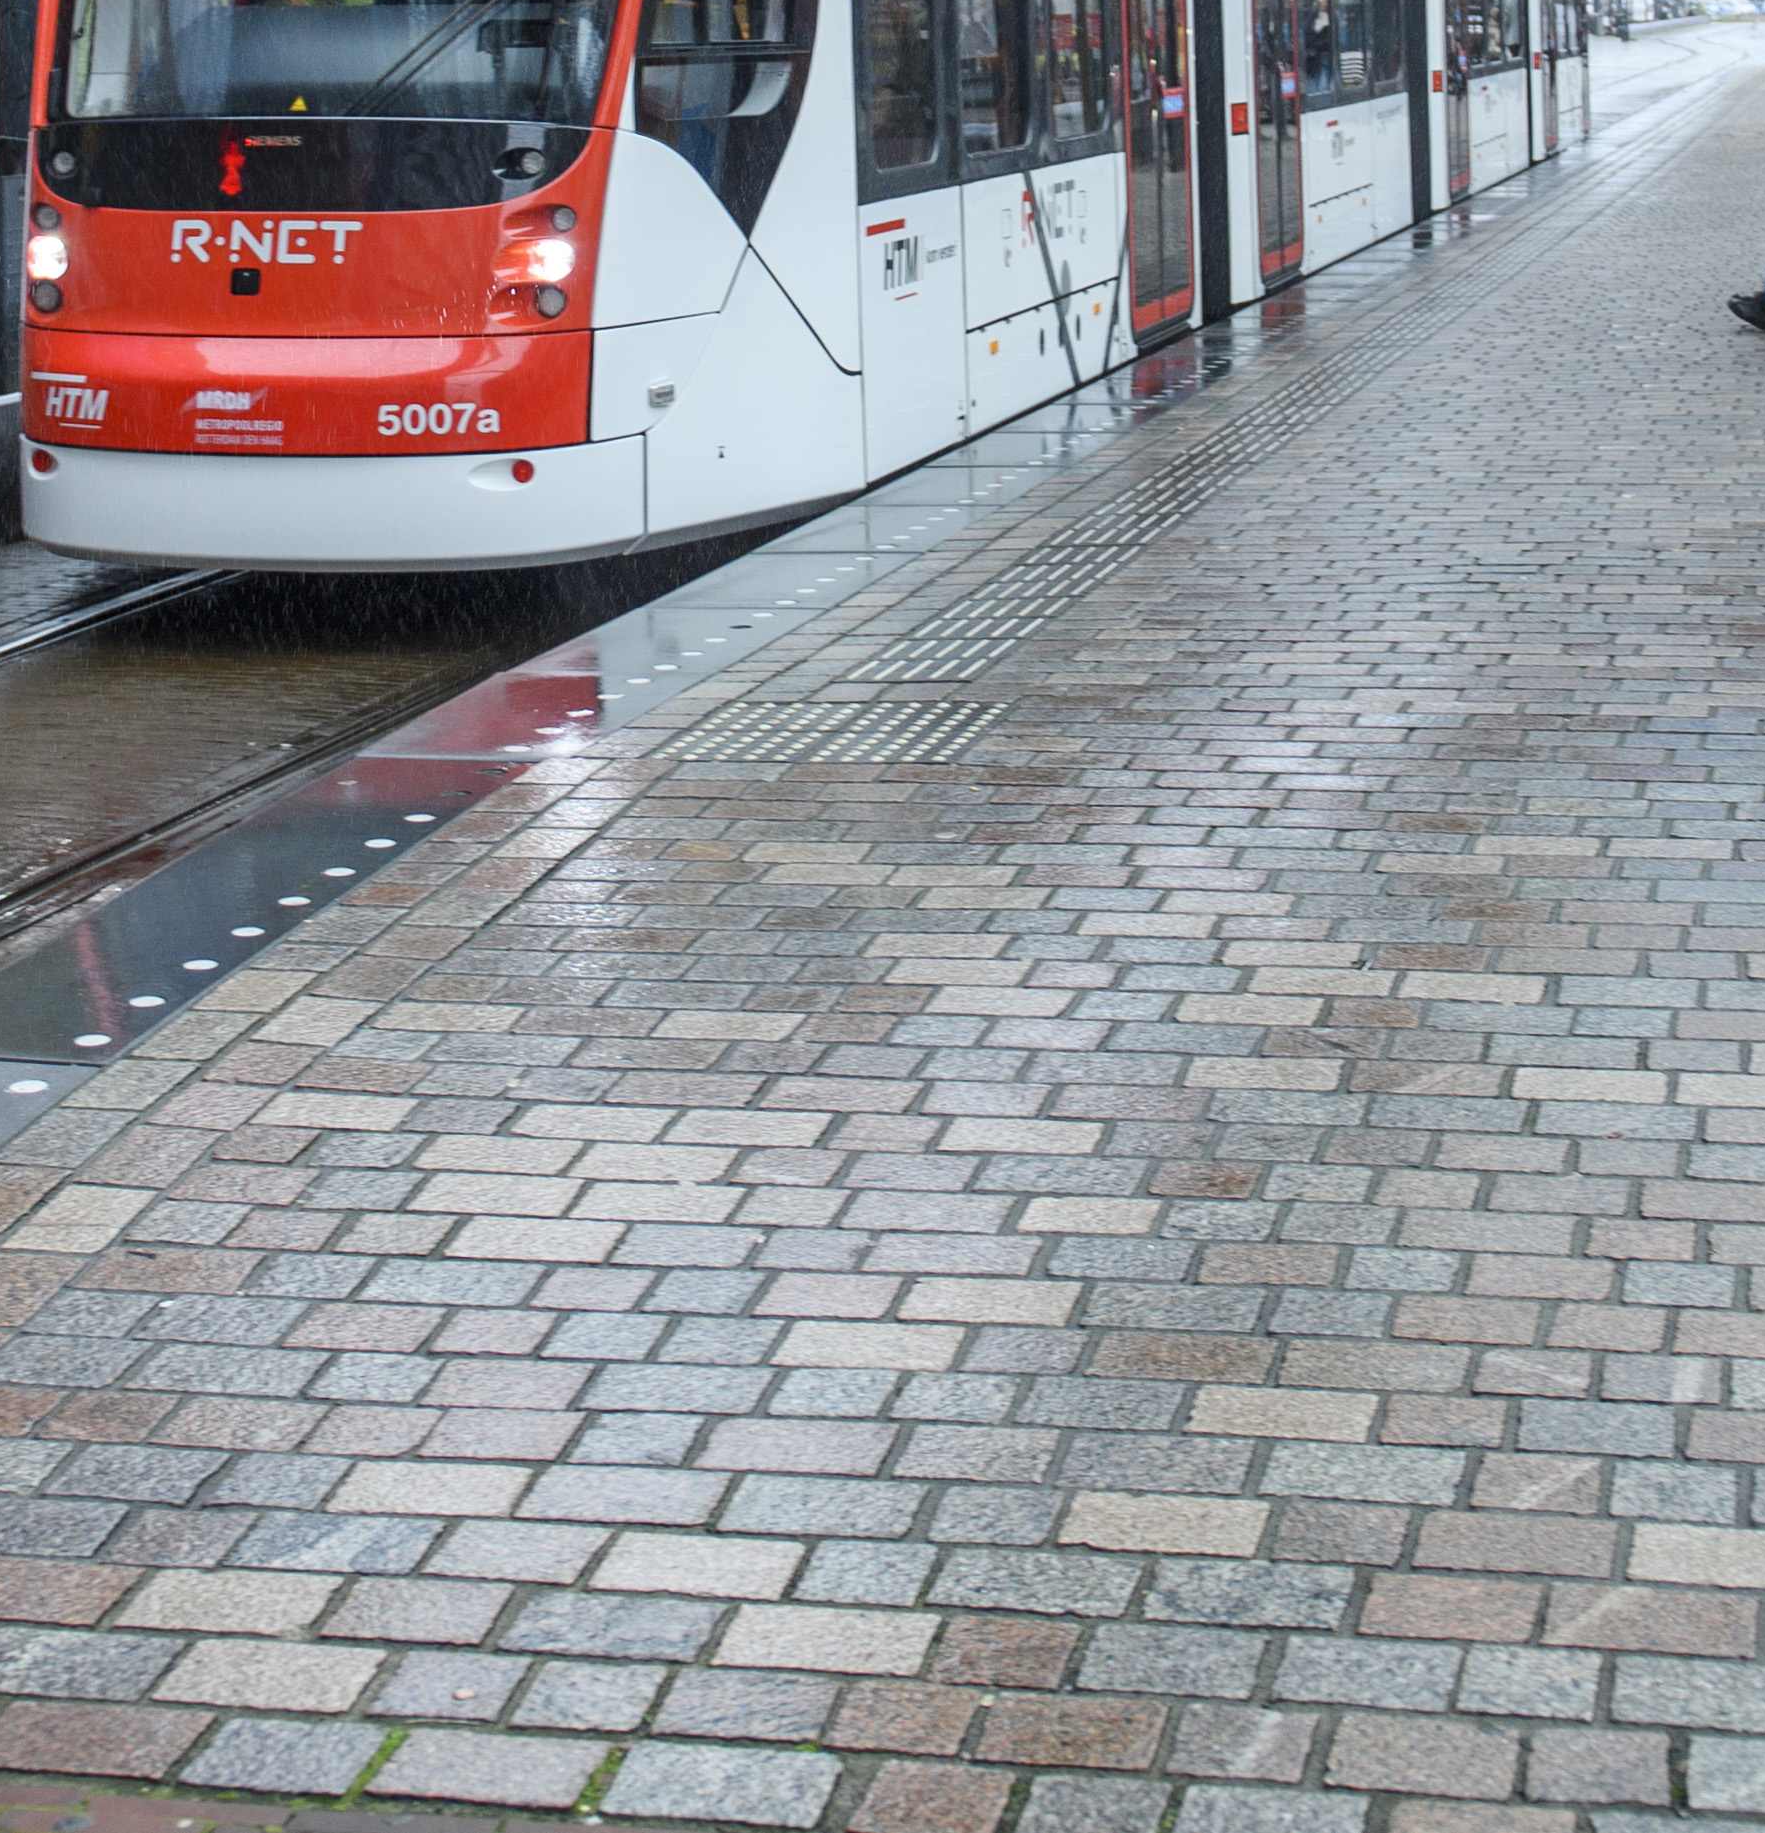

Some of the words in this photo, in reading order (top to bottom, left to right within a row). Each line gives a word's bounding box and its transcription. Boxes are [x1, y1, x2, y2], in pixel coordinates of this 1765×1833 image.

[245, 135, 303, 147] SIEMENS
[883, 235, 919, 291] HTM
[45, 386, 110, 421] HTM
[195, 390, 252, 411] MRDH
[194, 418, 284, 432] METROPOOLREGIO
[377, 402, 501, 436] 5007a
